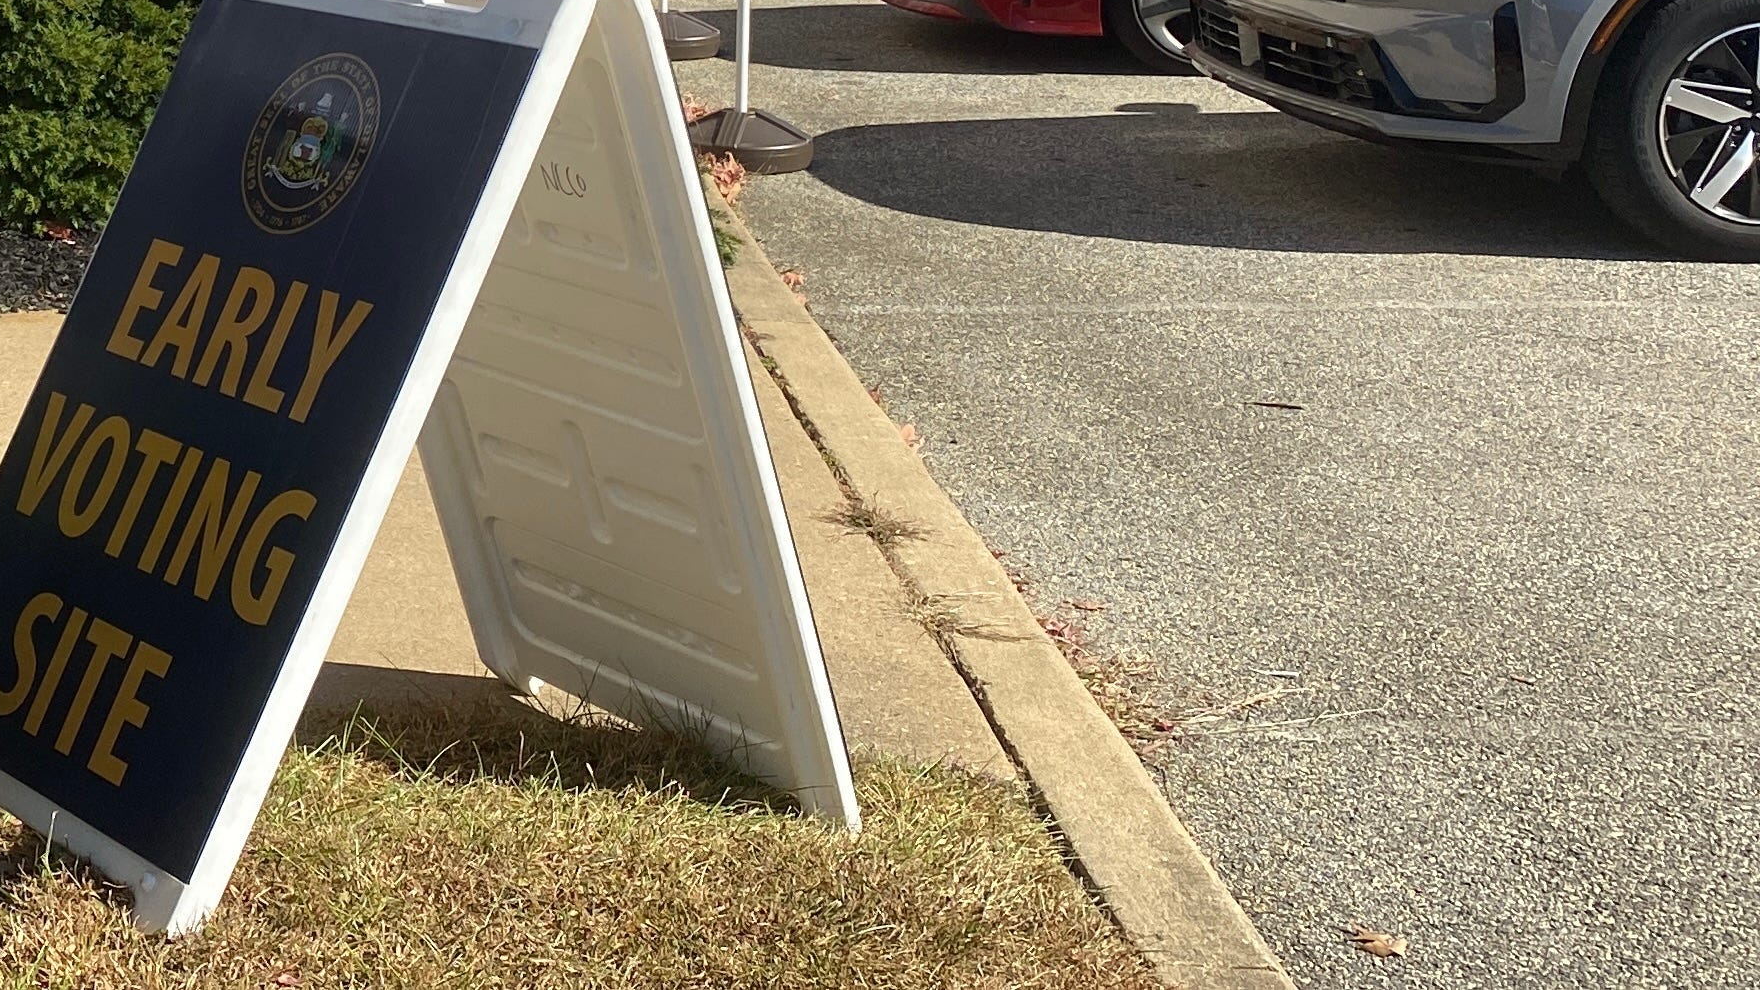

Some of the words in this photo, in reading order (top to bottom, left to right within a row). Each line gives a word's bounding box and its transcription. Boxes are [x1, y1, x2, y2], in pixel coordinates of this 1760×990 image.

[312, 61, 340, 74] THE
[105, 239, 373, 421] EARLY
[16, 392, 317, 626] VOTING
